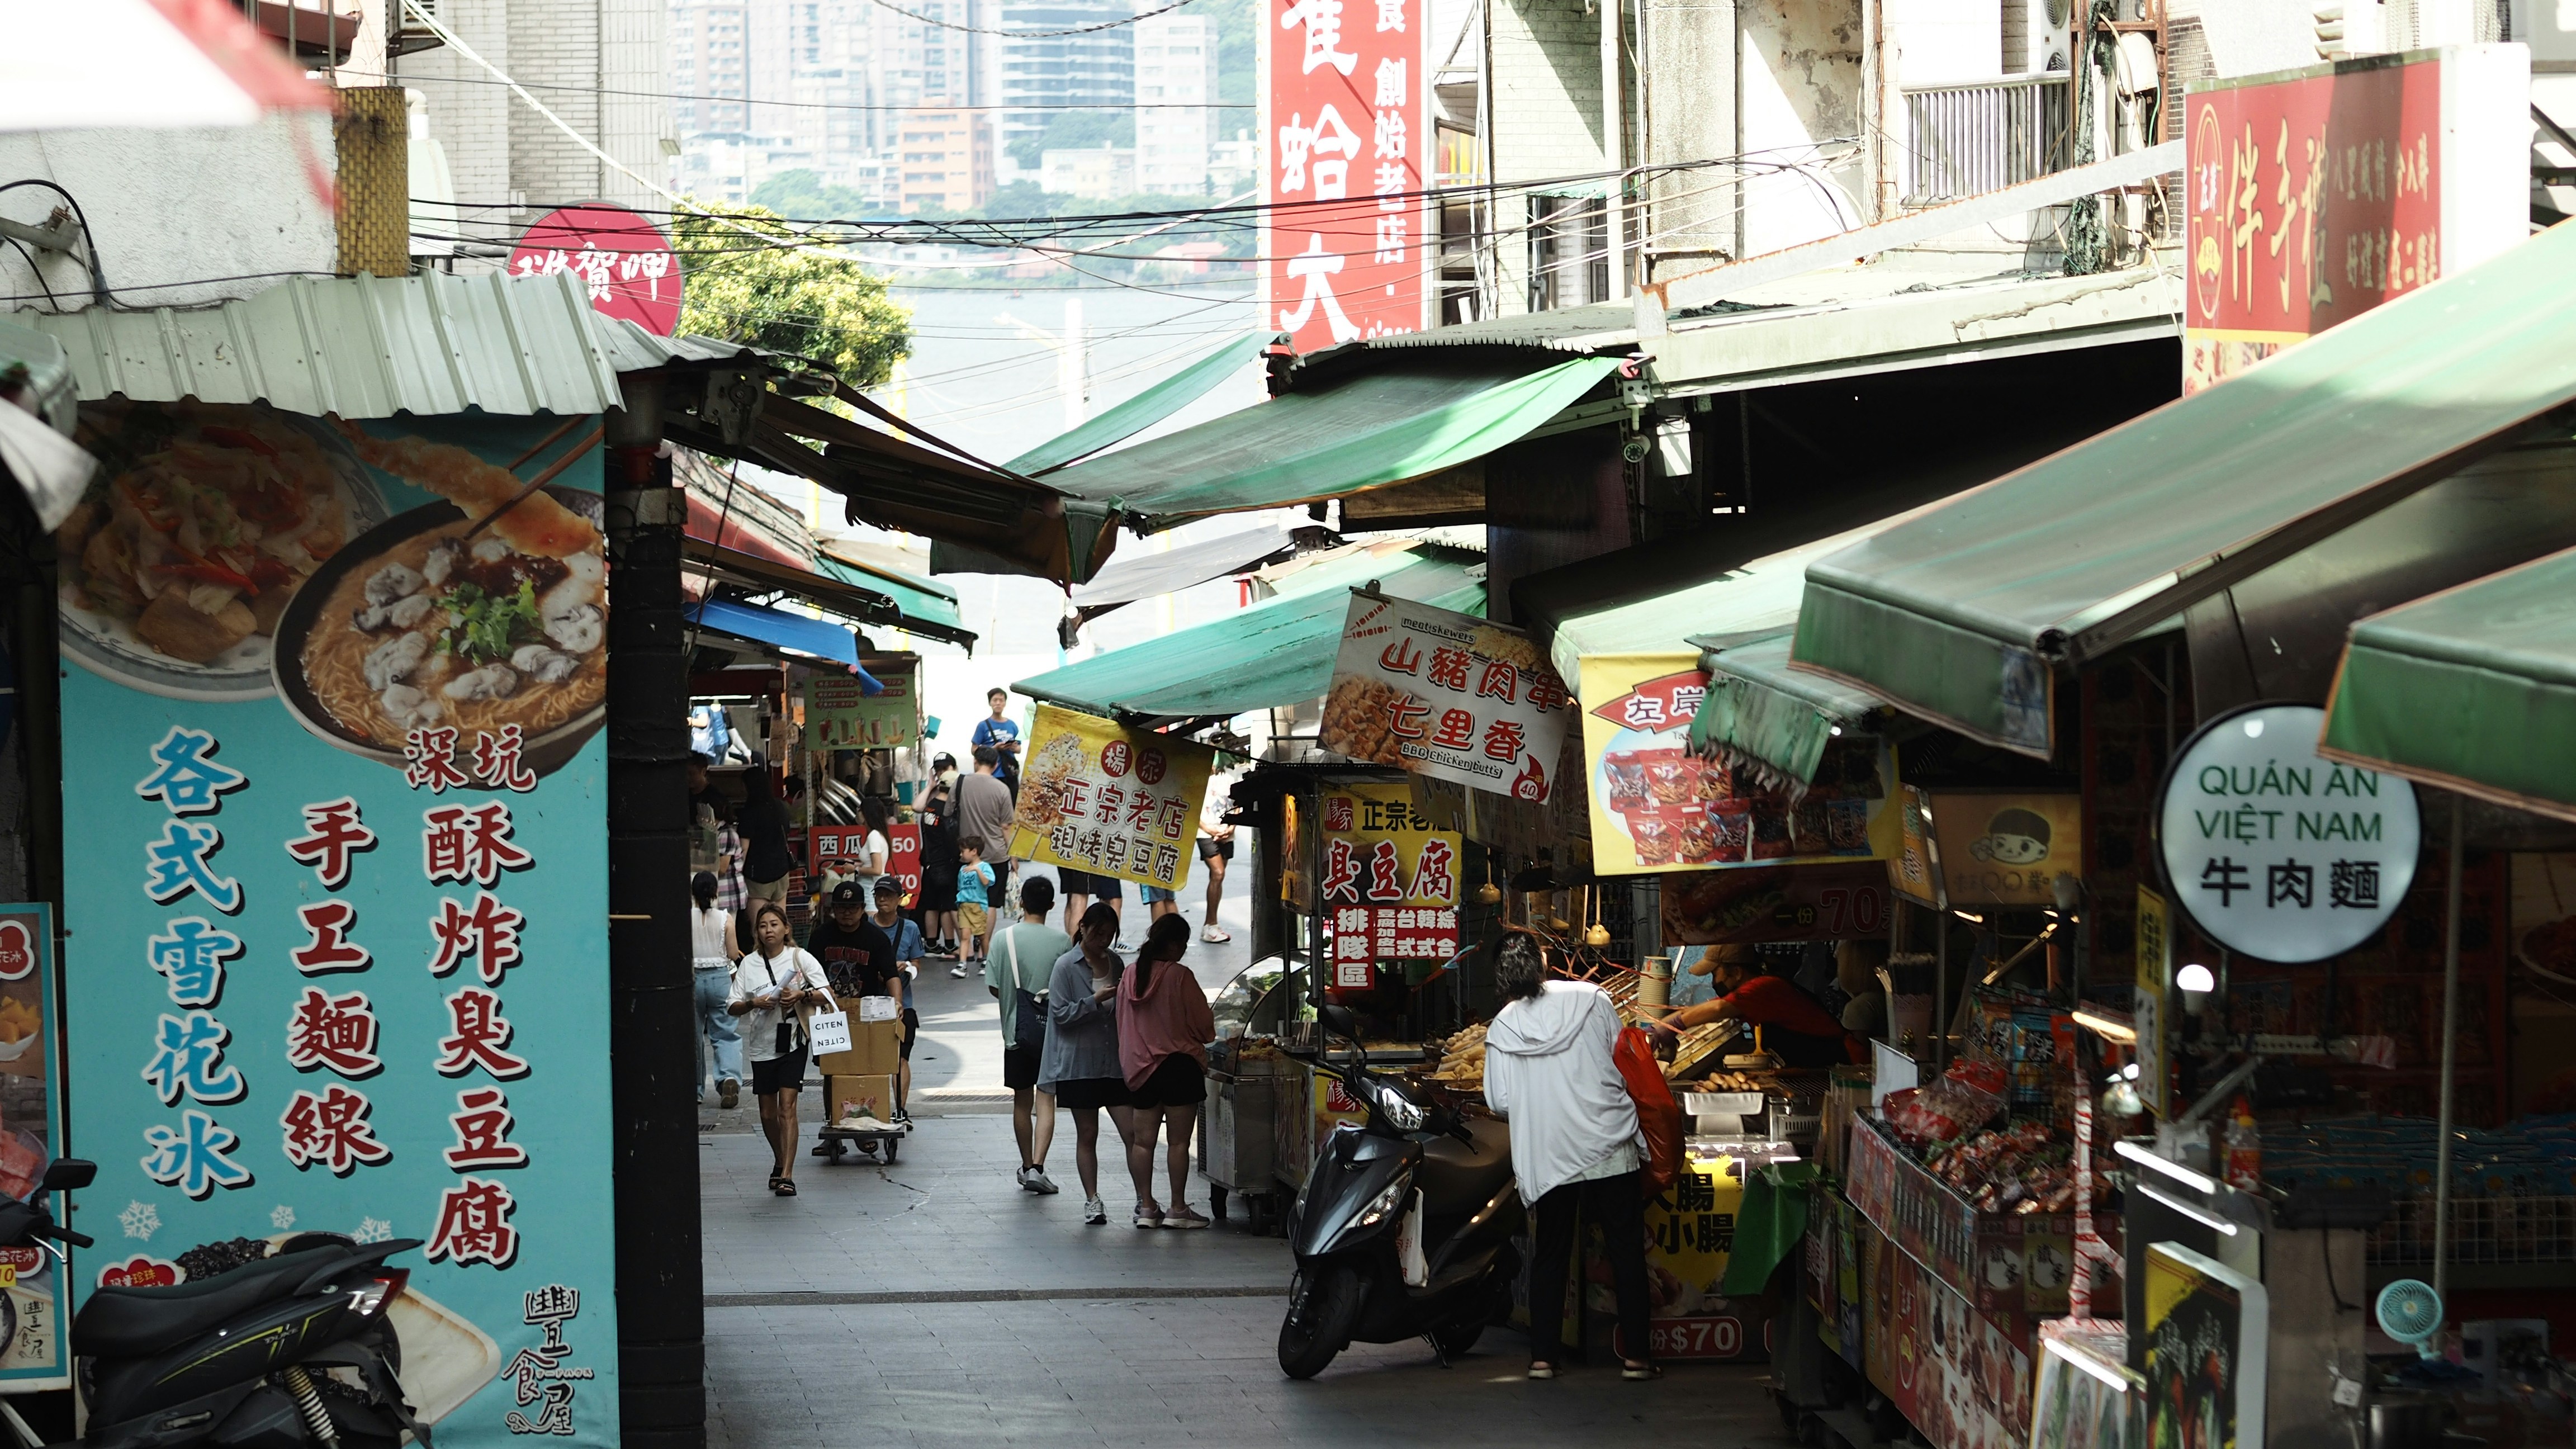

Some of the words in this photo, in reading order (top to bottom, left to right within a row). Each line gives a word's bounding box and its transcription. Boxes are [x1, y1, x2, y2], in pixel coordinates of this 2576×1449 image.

[1374, 57, 1408, 264] 創始老店
[1403, 617, 1430, 632] meat
[1431, 624, 1476, 642] skewers
[1379, 636, 1566, 713] 山豬肉串
[1386, 693, 1527, 765] 七里香
[1625, 685, 1707, 726] 左岸
[405, 723, 537, 793] 深坑
[1402, 742, 1428, 758] BBQ
[1472, 760, 1500, 776] butts
[2199, 759, 2312, 797] QUÁN
[1058, 776, 1190, 841] 正宗老店
[1520, 783, 1536, 796] 40
[1362, 800, 1452, 832] 正宗老
[2195, 803, 2284, 845] VIỆT
[2296, 811, 2382, 842] NAM
[818, 834, 862, 856] 西瓜
[892, 836, 916, 854] 50
[1049, 823, 1181, 884] 現烤臭豆腐
[1323, 838, 1455, 903] 臭豆腐
[2200, 856, 2380, 910] 牛肉麵
[1337, 907, 1370, 987] 排隊區
[1396, 909, 1416, 957] 台式
[1417, 909, 1436, 957] 韓式
[1436, 909, 1456, 957] 綜合
[136, 725, 252, 1197] 各式雪花冰
[280, 796, 391, 1173] 手工麵線
[424, 799, 533, 1266] 酥炸臭豆腐
[815, 1020, 843, 1030] CITEN
[817, 1036, 846, 1047] CITEN
[1656, 1212, 1735, 1254] 小腸
